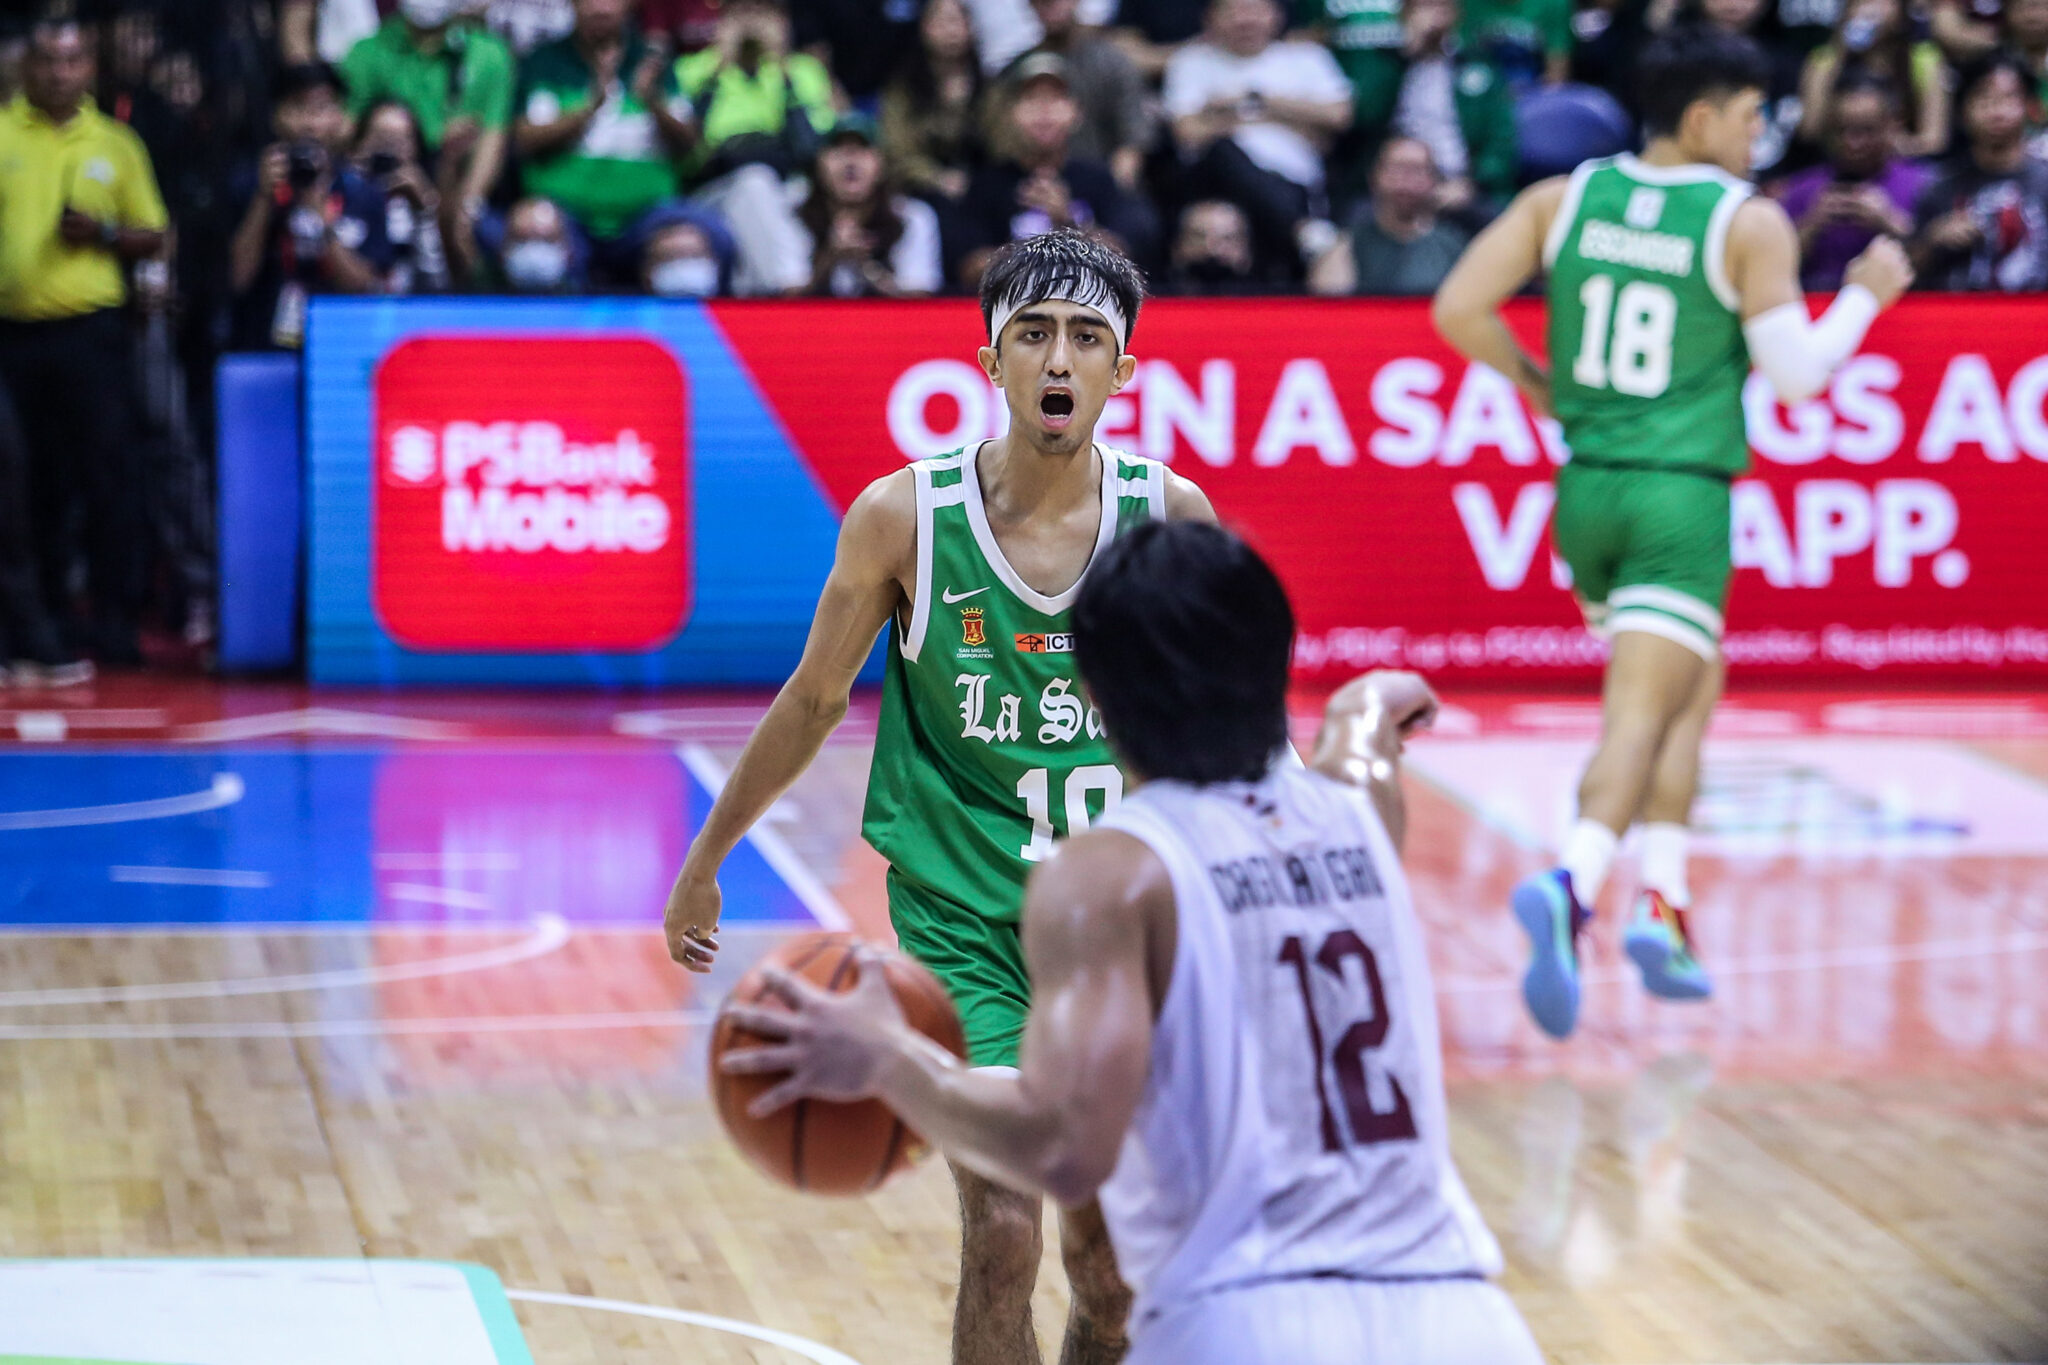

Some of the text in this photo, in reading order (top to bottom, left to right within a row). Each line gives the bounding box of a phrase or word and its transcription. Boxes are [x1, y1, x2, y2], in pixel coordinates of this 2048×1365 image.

[1573, 273, 1678, 399] 18
[441, 420, 657, 487] PSBank
[885, 358, 1237, 467] OEN
[1250, 357, 1358, 467] A
[1367, 354, 1905, 467] SAGS
[441, 484, 671, 553] Mobile
[954, 673, 1022, 745] La
[1016, 764, 1124, 863] 10
[1277, 928, 1419, 1153] 12
